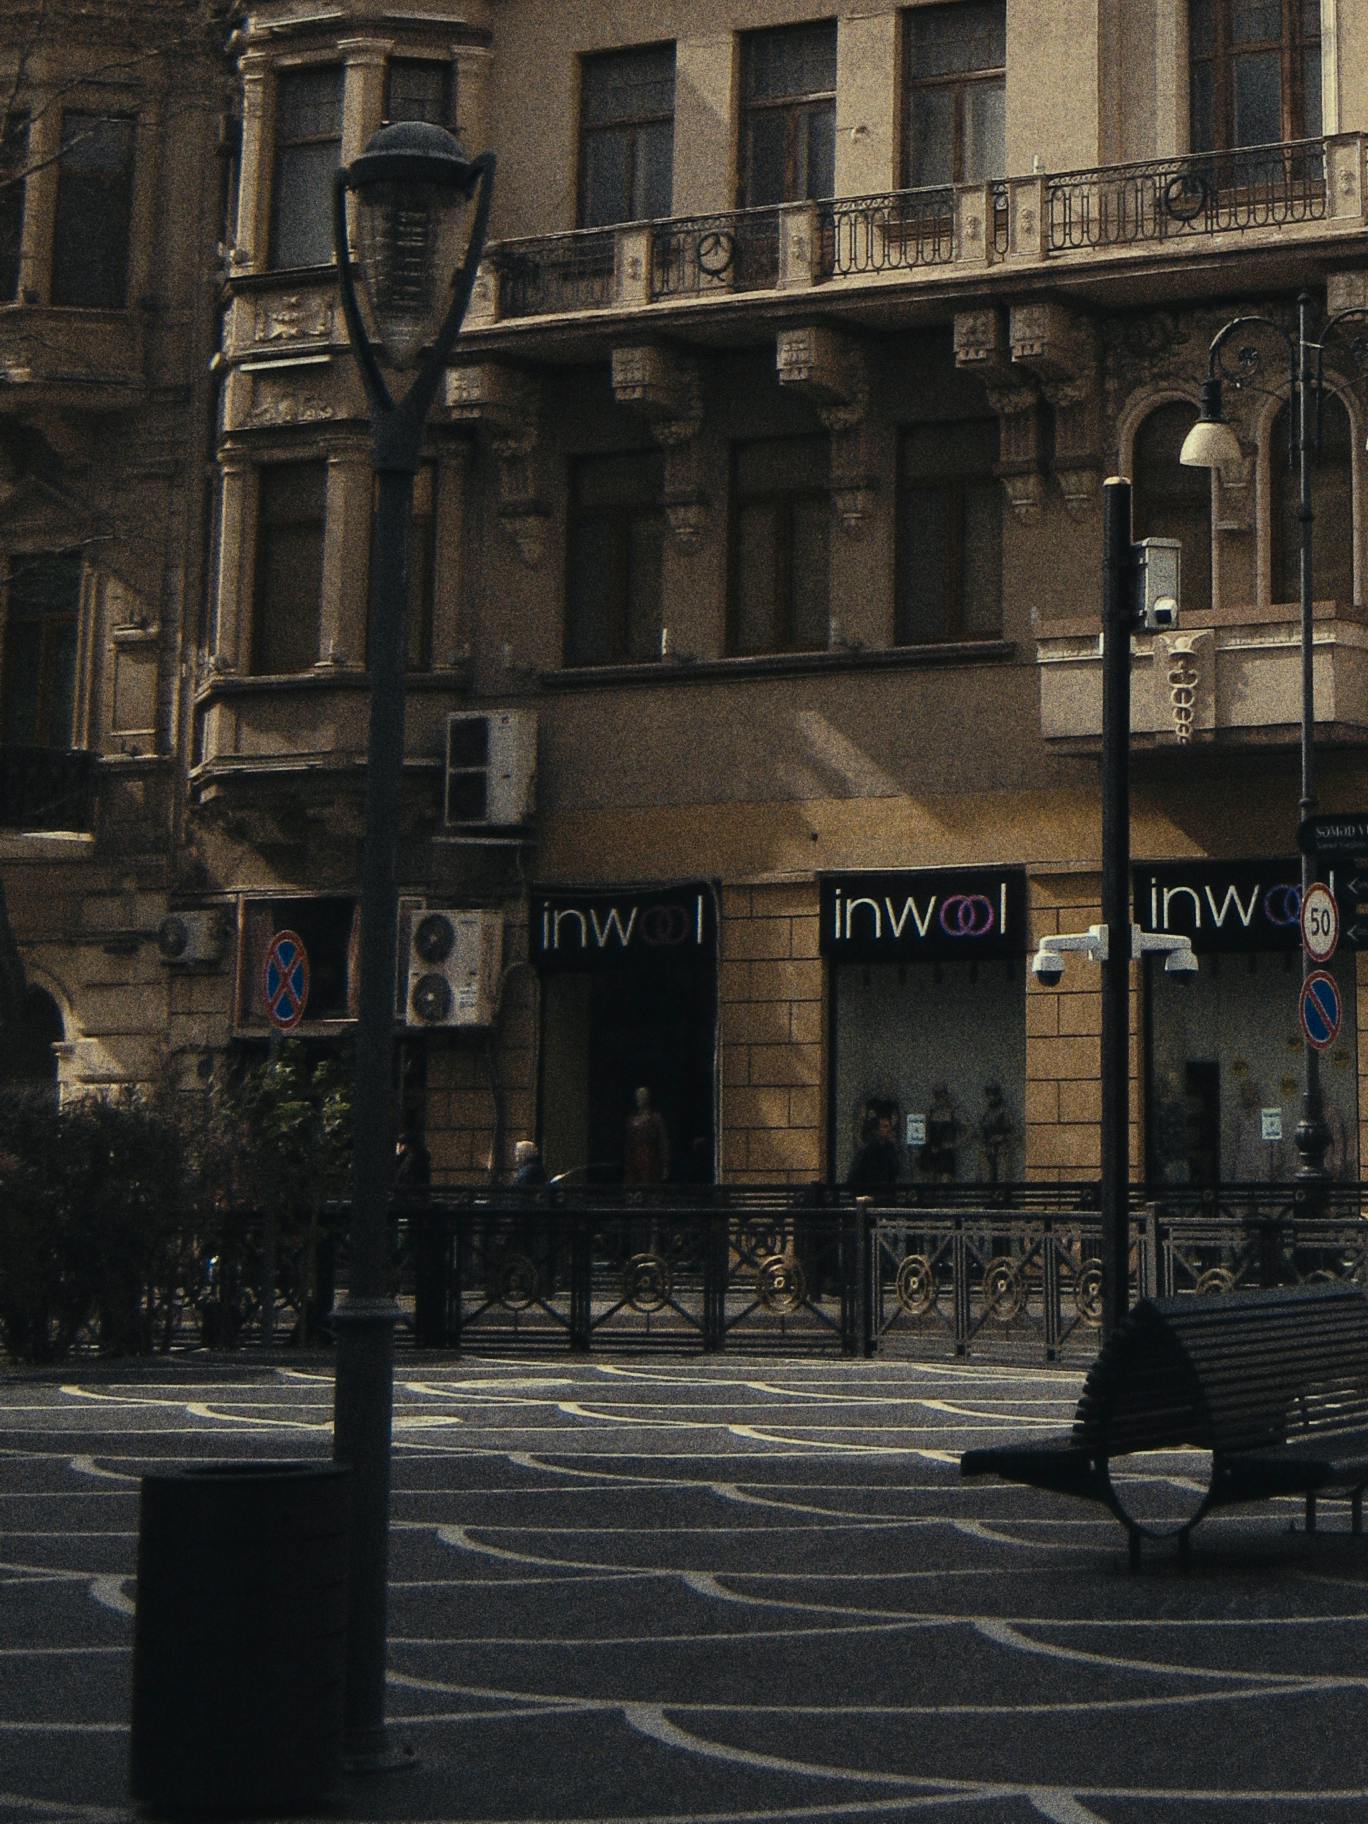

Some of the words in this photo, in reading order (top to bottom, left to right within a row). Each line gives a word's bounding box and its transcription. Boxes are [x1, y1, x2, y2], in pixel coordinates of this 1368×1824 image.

[541, 894, 704, 951] inwool
[834, 881, 1008, 940] inwool
[1150, 870, 1336, 929] inwo
[1310, 907, 1331, 936] 50
